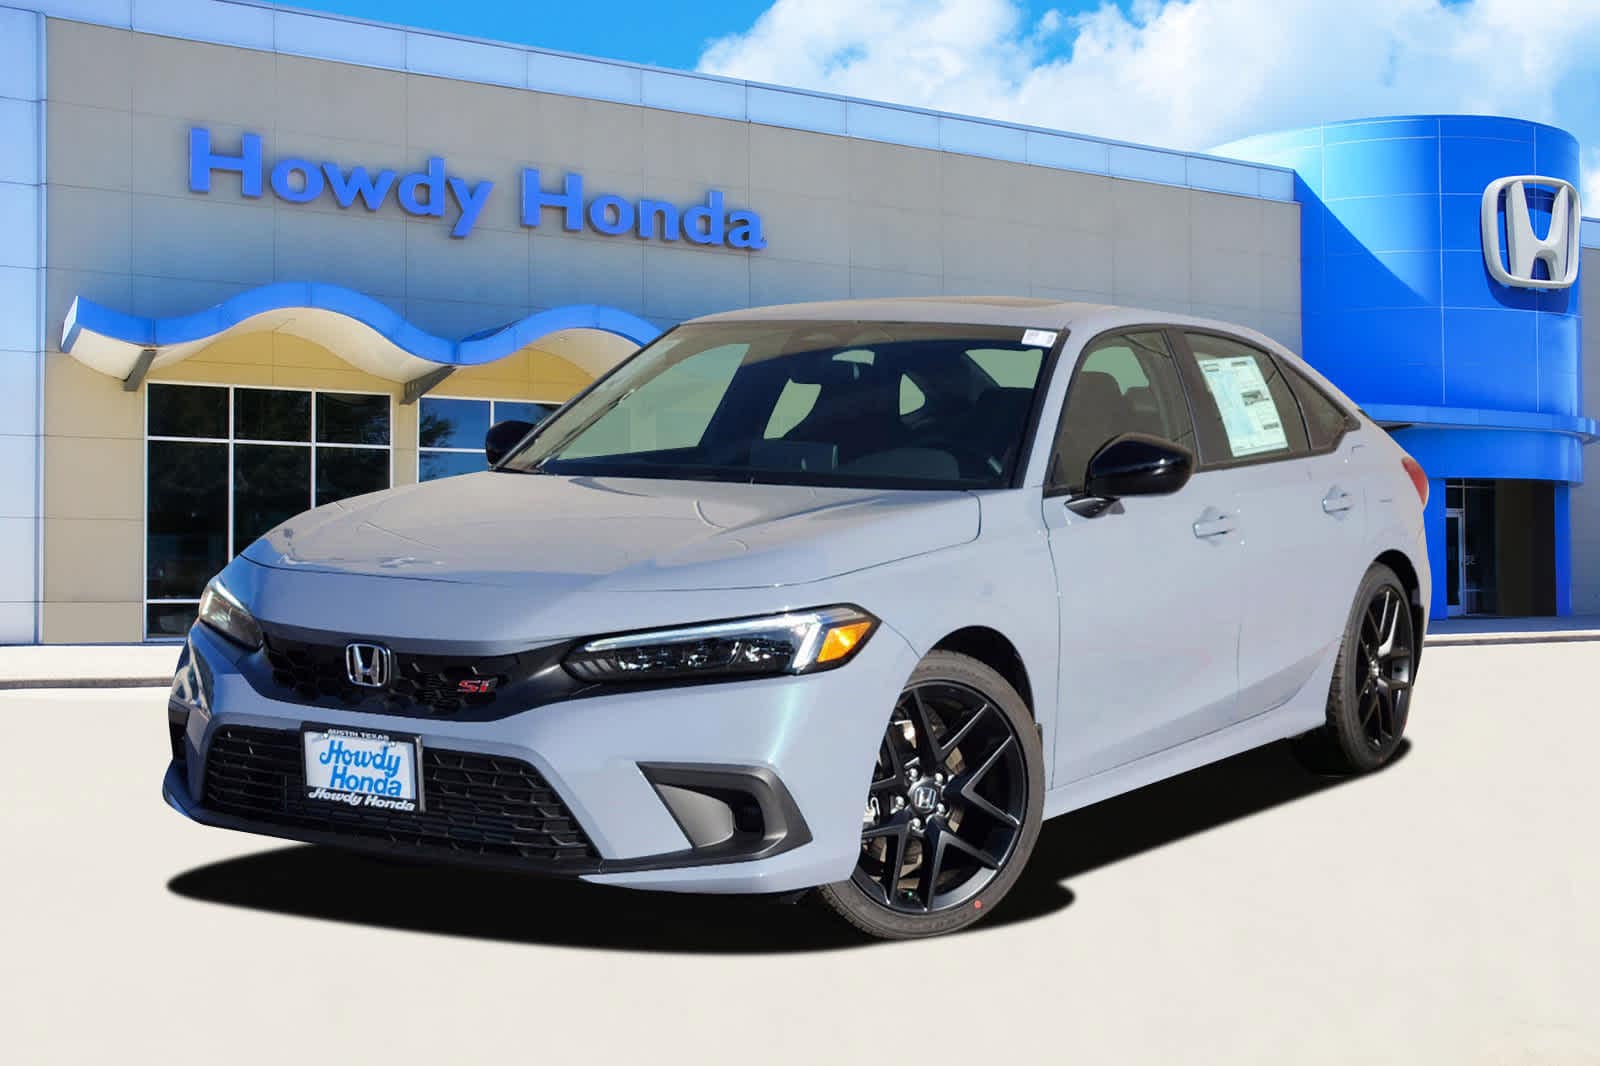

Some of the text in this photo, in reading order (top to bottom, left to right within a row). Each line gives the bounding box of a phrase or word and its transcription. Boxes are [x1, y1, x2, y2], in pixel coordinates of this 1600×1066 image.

[189, 127, 768, 250] Howdy Honda
[327, 728, 390, 741] AUSTIN TEXAS
[320, 740, 401, 779] Howdy
[329, 765, 402, 797] Honda
[308, 787, 416, 812] Howdy Honda
